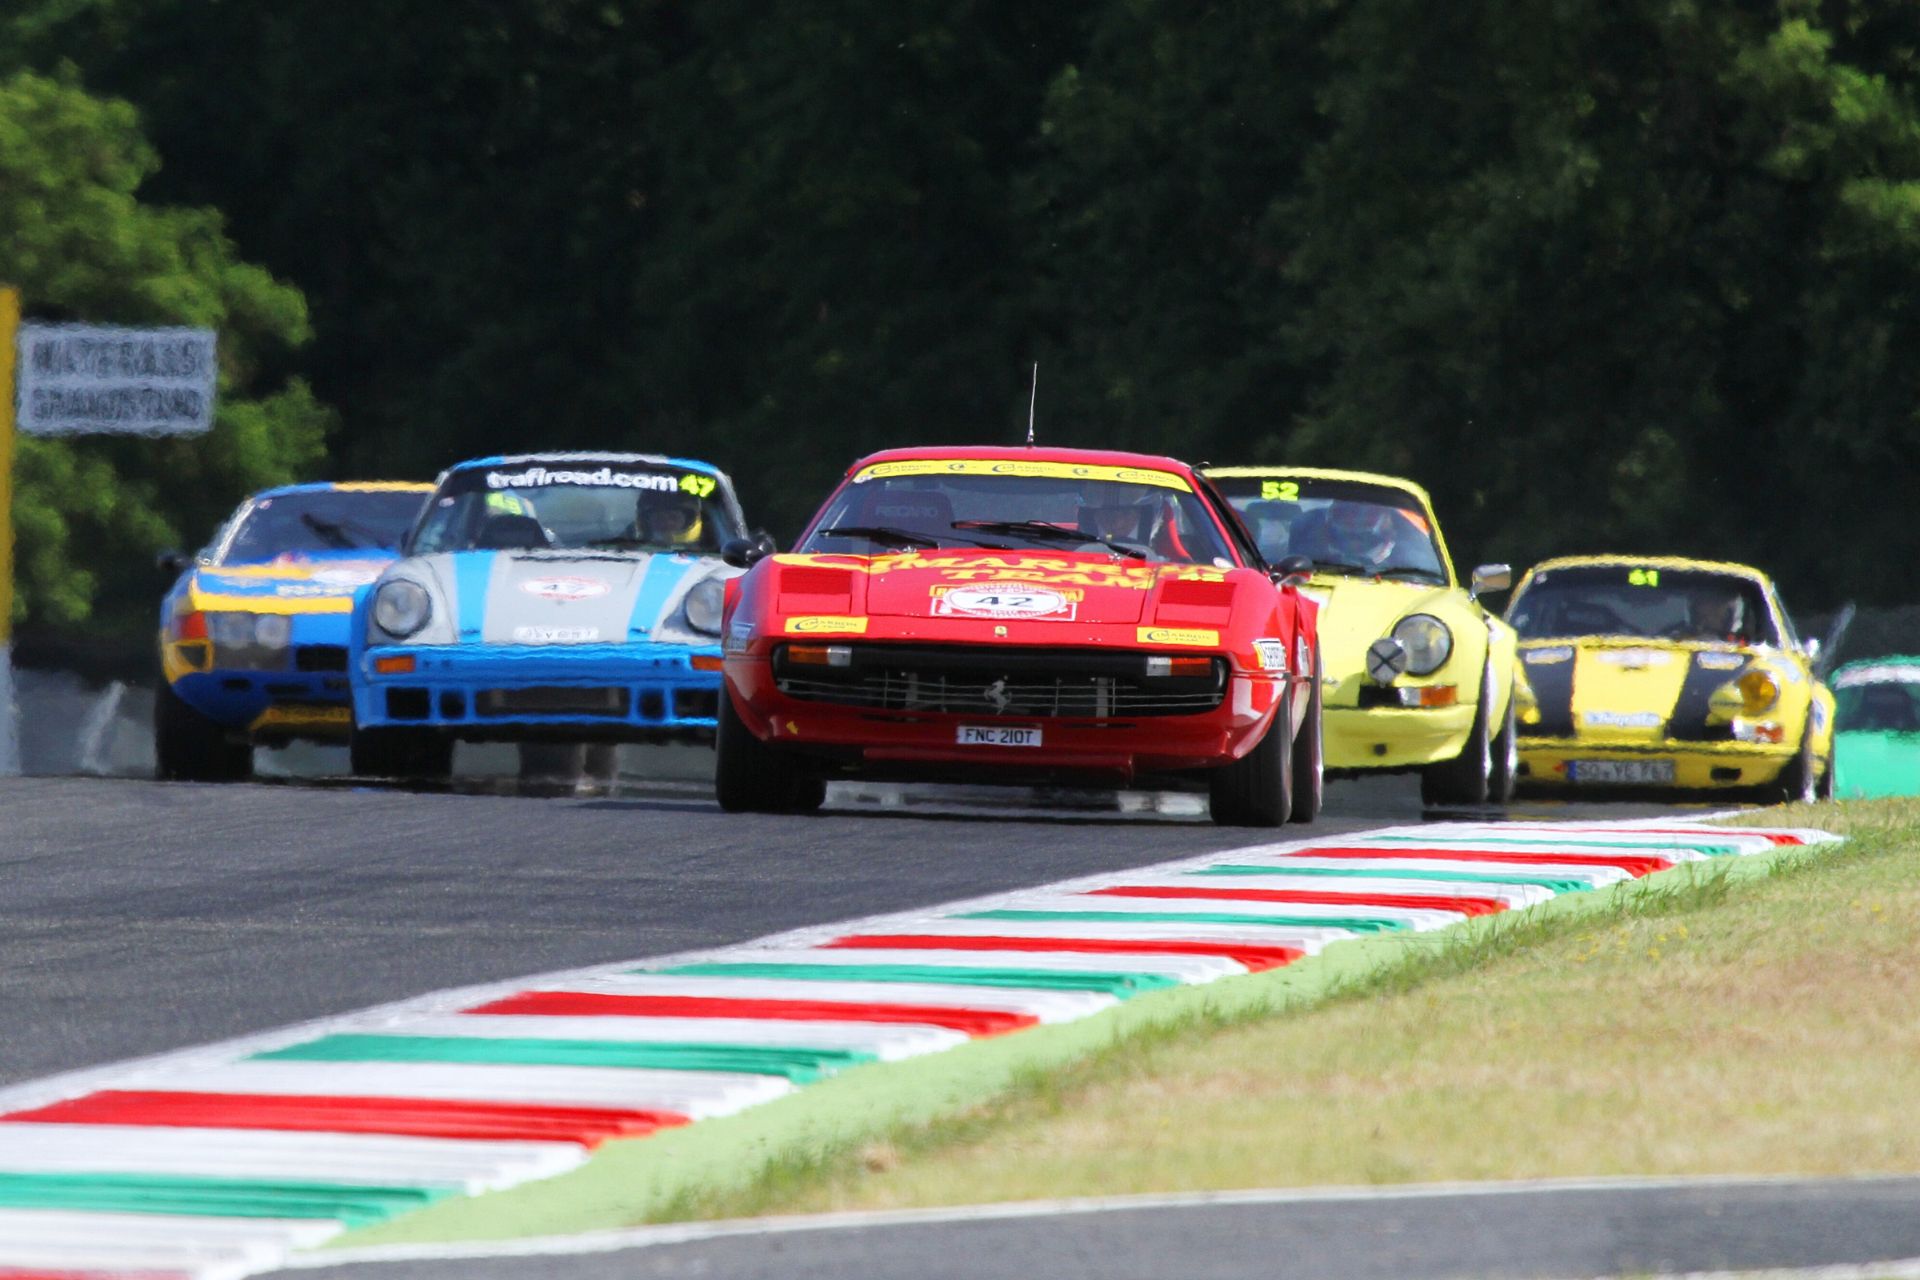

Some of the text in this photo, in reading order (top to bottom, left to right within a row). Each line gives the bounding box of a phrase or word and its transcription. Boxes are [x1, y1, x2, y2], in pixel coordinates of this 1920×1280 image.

[680, 474, 716, 498] 47
[1261, 481, 1299, 501] 52
[940, 569, 1156, 590] TEAM
[975, 595, 1037, 607] 42
[964, 727, 1034, 745] FNC 210T
